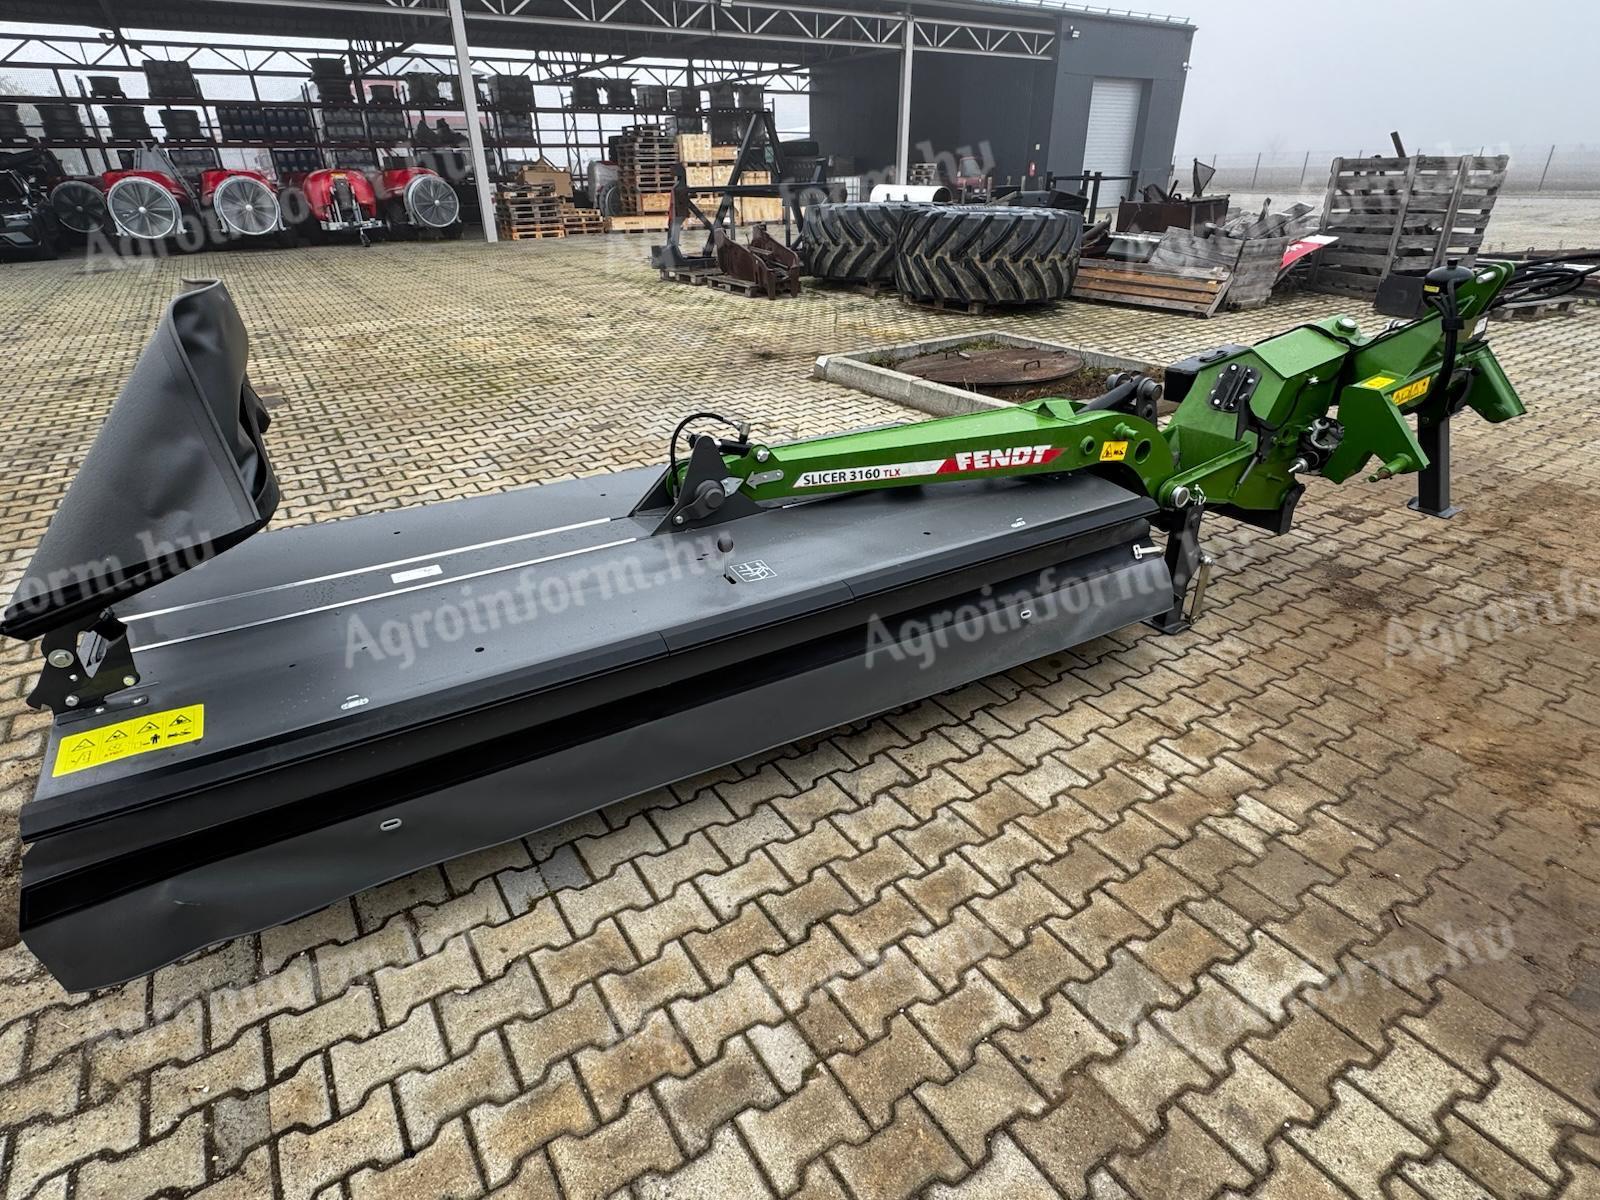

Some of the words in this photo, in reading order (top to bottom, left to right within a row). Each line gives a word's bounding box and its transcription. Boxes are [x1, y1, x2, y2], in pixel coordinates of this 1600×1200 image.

[955, 445, 1051, 471] FENDT
[803, 471, 847, 485] SLICER
[850, 468, 881, 481] 3160
[883, 468, 901, 478] TLX
